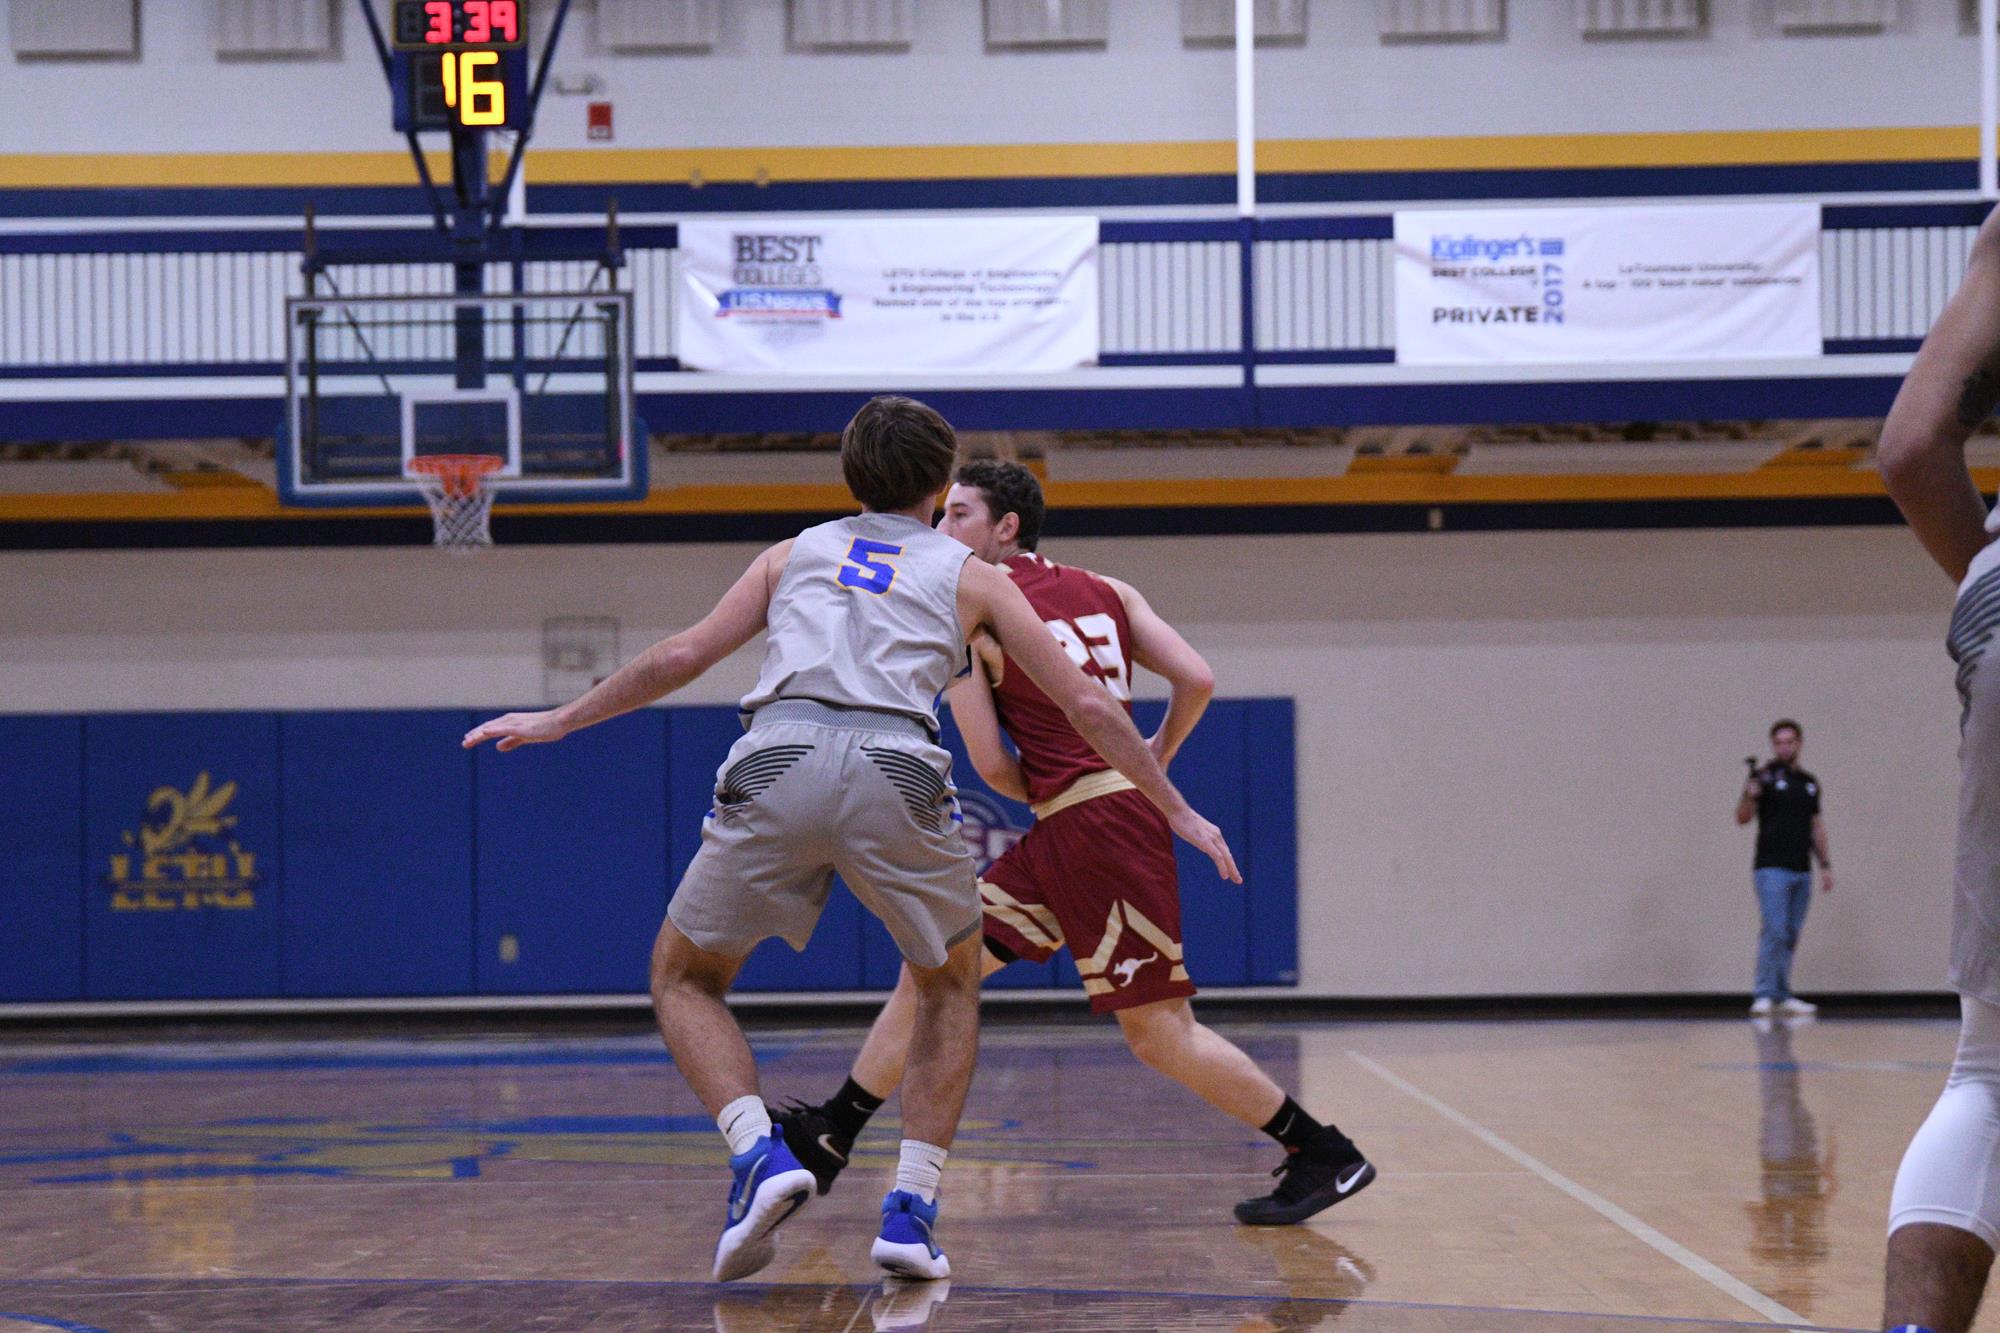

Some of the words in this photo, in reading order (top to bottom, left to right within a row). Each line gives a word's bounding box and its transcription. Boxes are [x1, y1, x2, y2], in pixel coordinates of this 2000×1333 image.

[442, 52, 505, 125] 16
[733, 234, 822, 262] BEST
[1433, 306, 1538, 323] PRIVATE
[1543, 262, 1563, 323] 2017
[836, 535, 906, 597] 5
